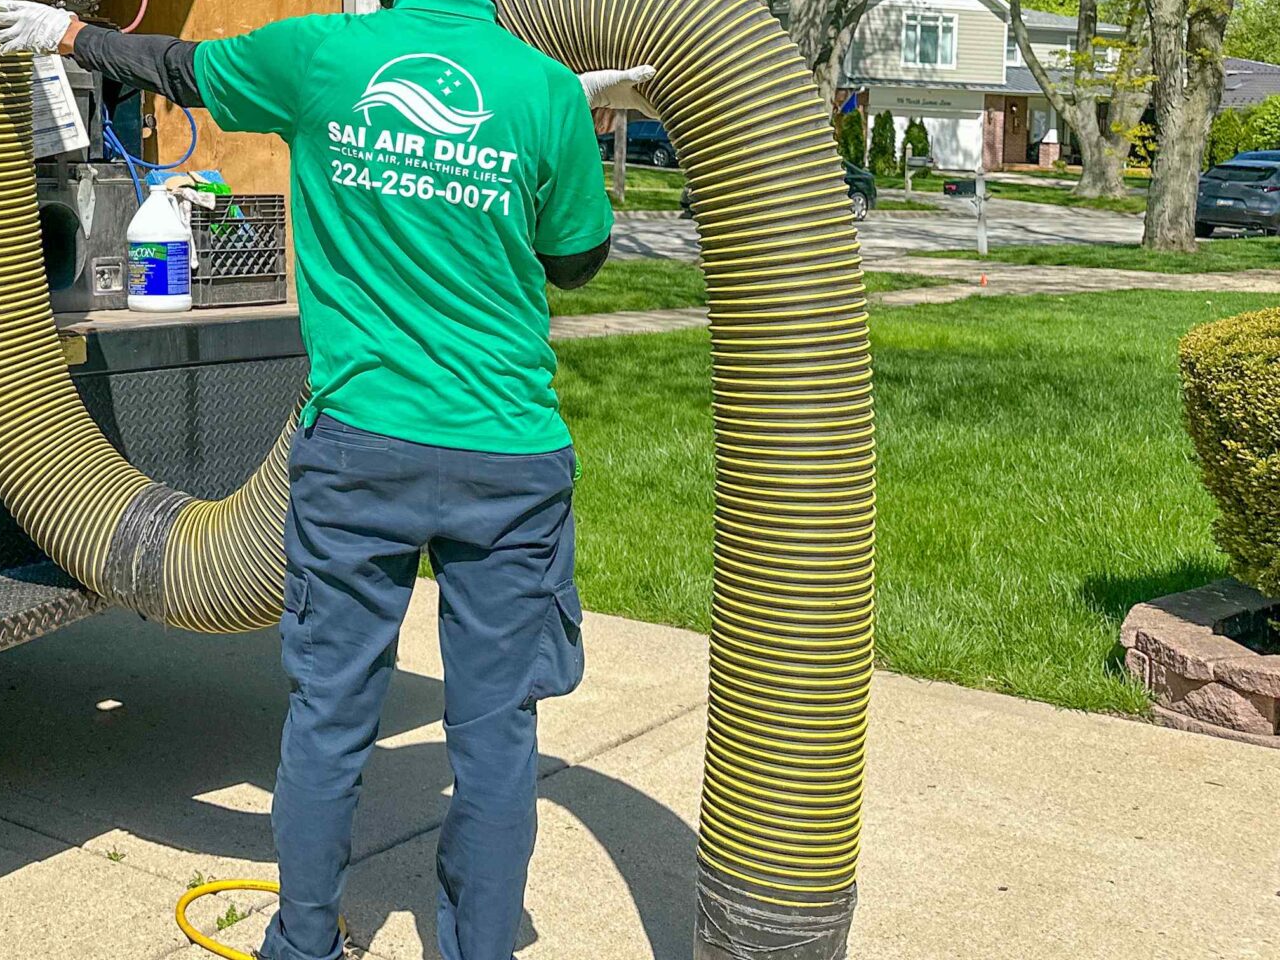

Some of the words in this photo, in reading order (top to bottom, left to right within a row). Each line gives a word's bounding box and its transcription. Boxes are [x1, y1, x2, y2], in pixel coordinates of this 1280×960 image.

[328, 121, 366, 148] SAI
[374, 130, 426, 157] AIR
[434, 139, 518, 172] DUCT
[341, 146, 373, 161] CLEAN
[376, 153, 401, 166] AIR,
[405, 158, 469, 177] HEALTHIER
[473, 171, 497, 183] LIFE
[331, 160, 511, 216] 224-256-0071
